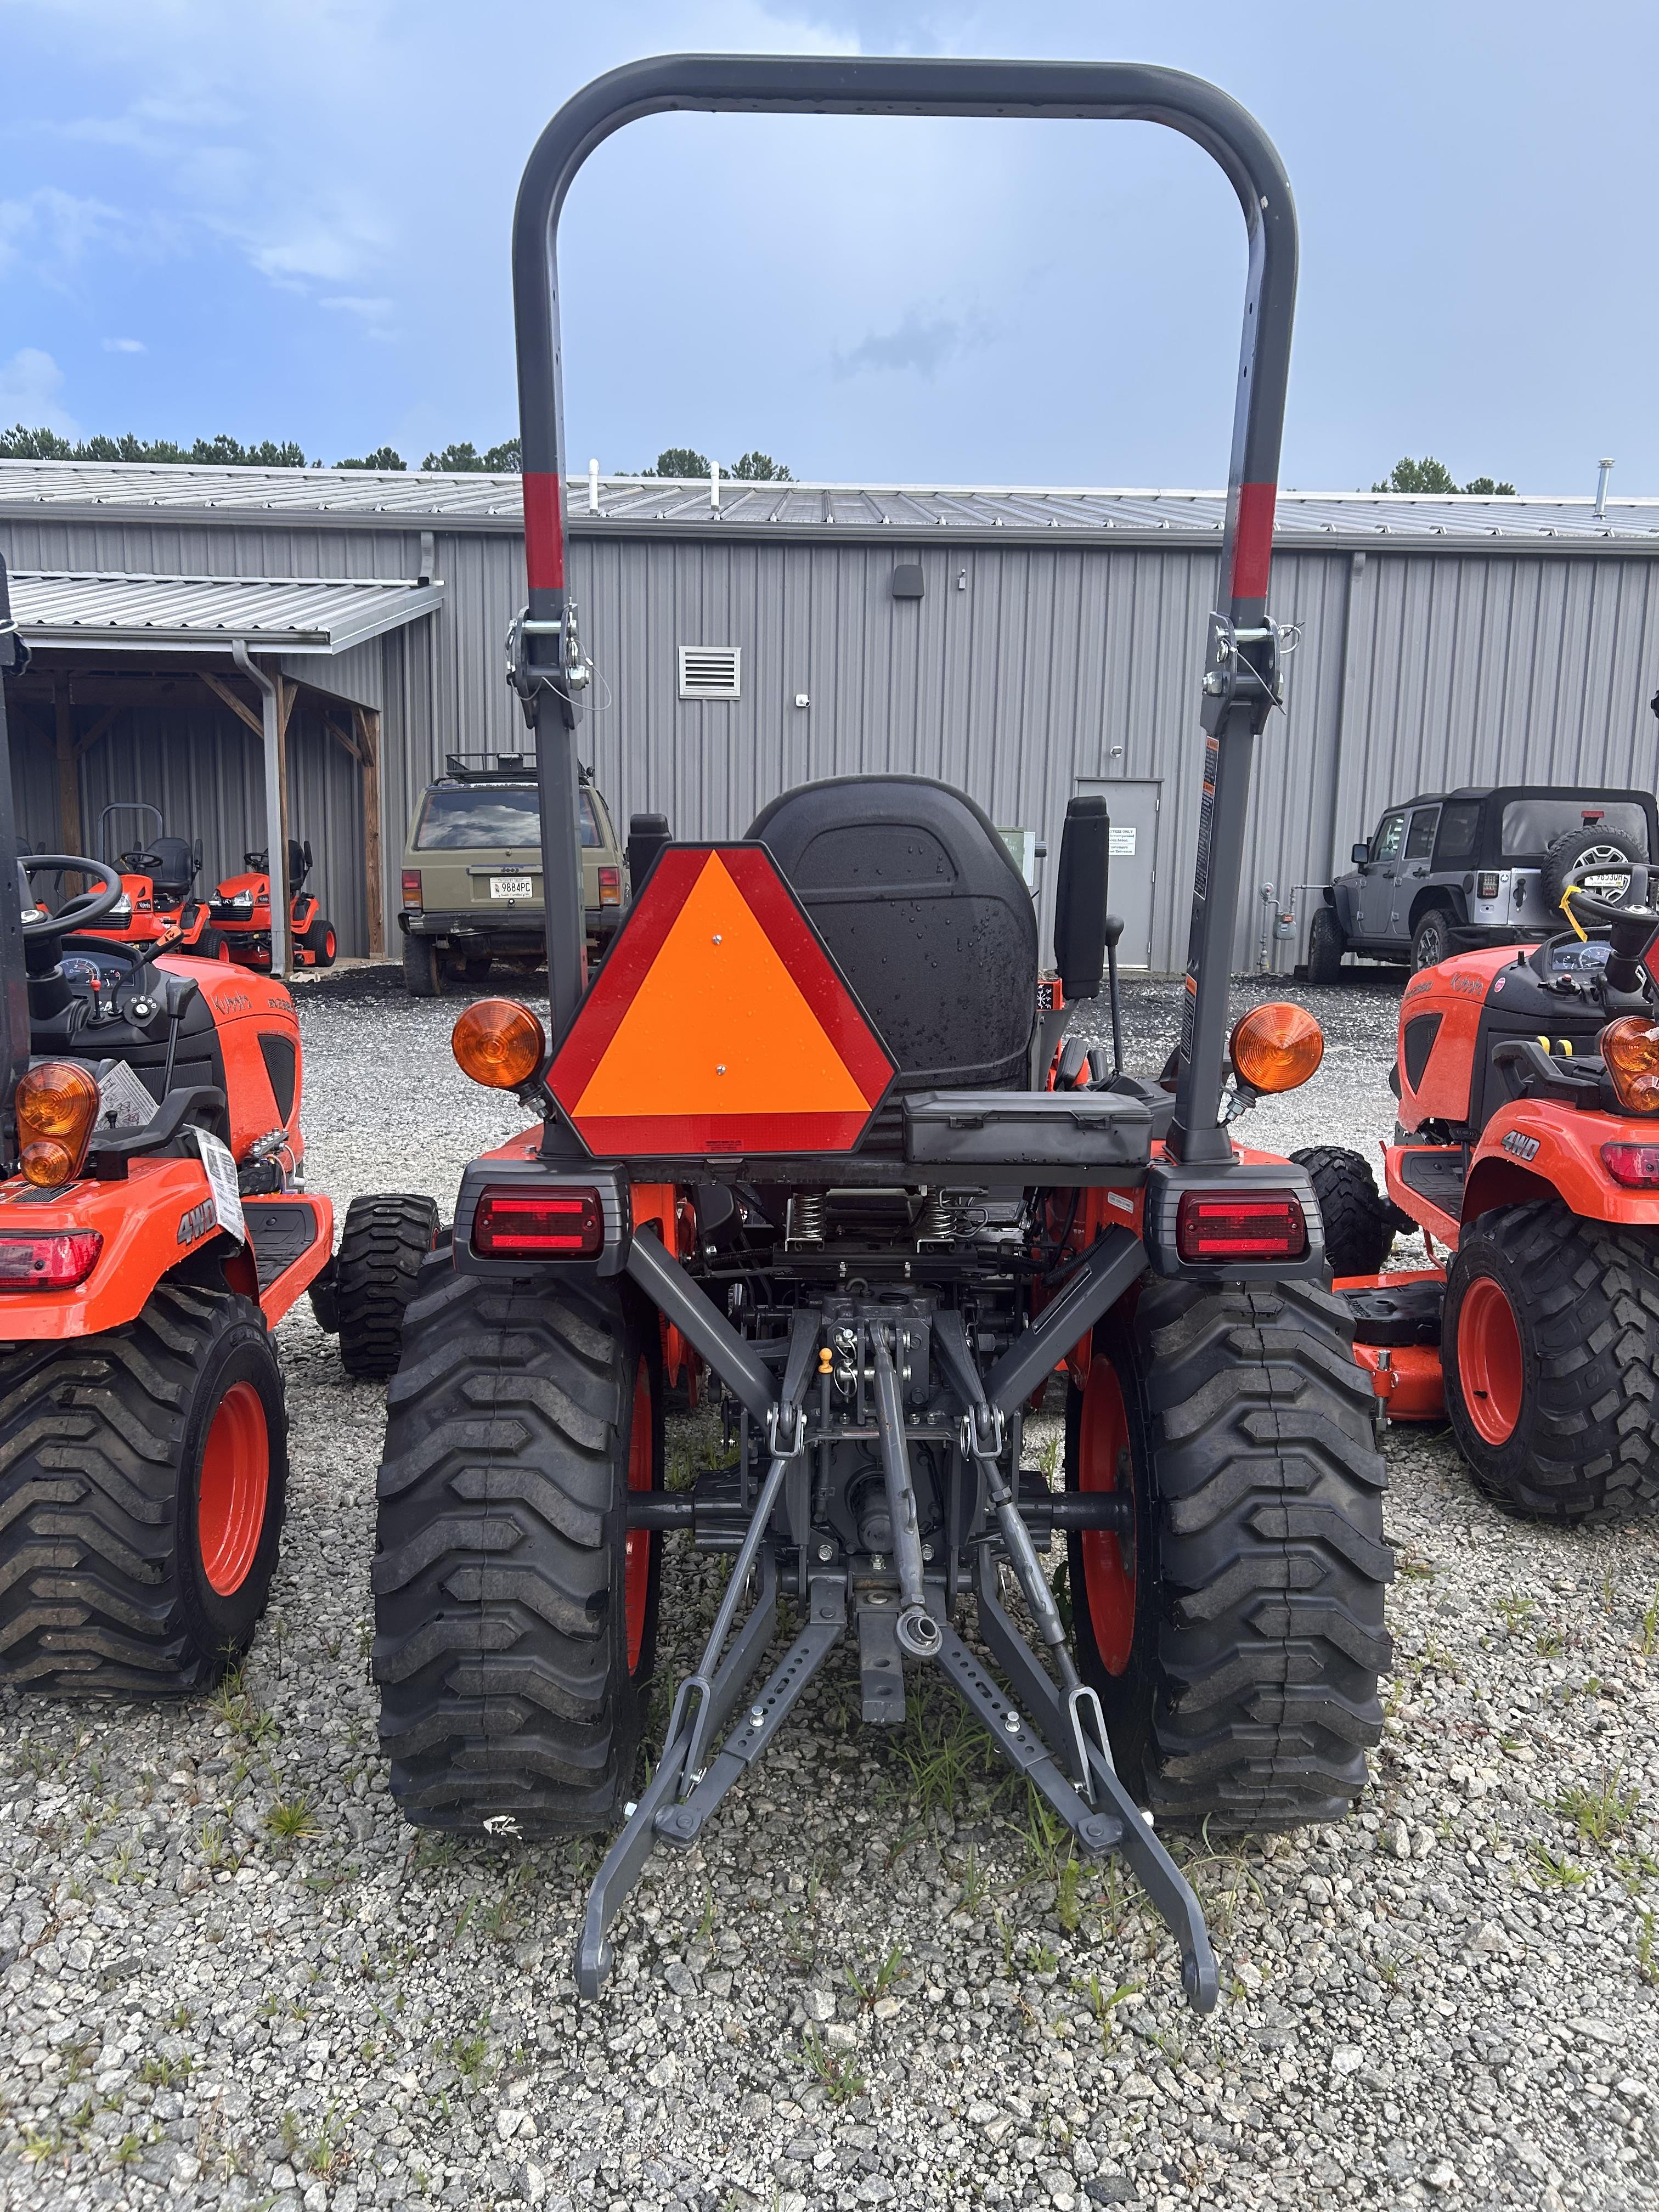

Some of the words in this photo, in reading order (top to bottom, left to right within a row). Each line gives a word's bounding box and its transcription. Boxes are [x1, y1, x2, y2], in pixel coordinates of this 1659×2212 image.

[502, 883, 530, 891] 9884PC
[1501, 1130, 1541, 1162] 4WD
[177, 1197, 217, 1246] 4WD
